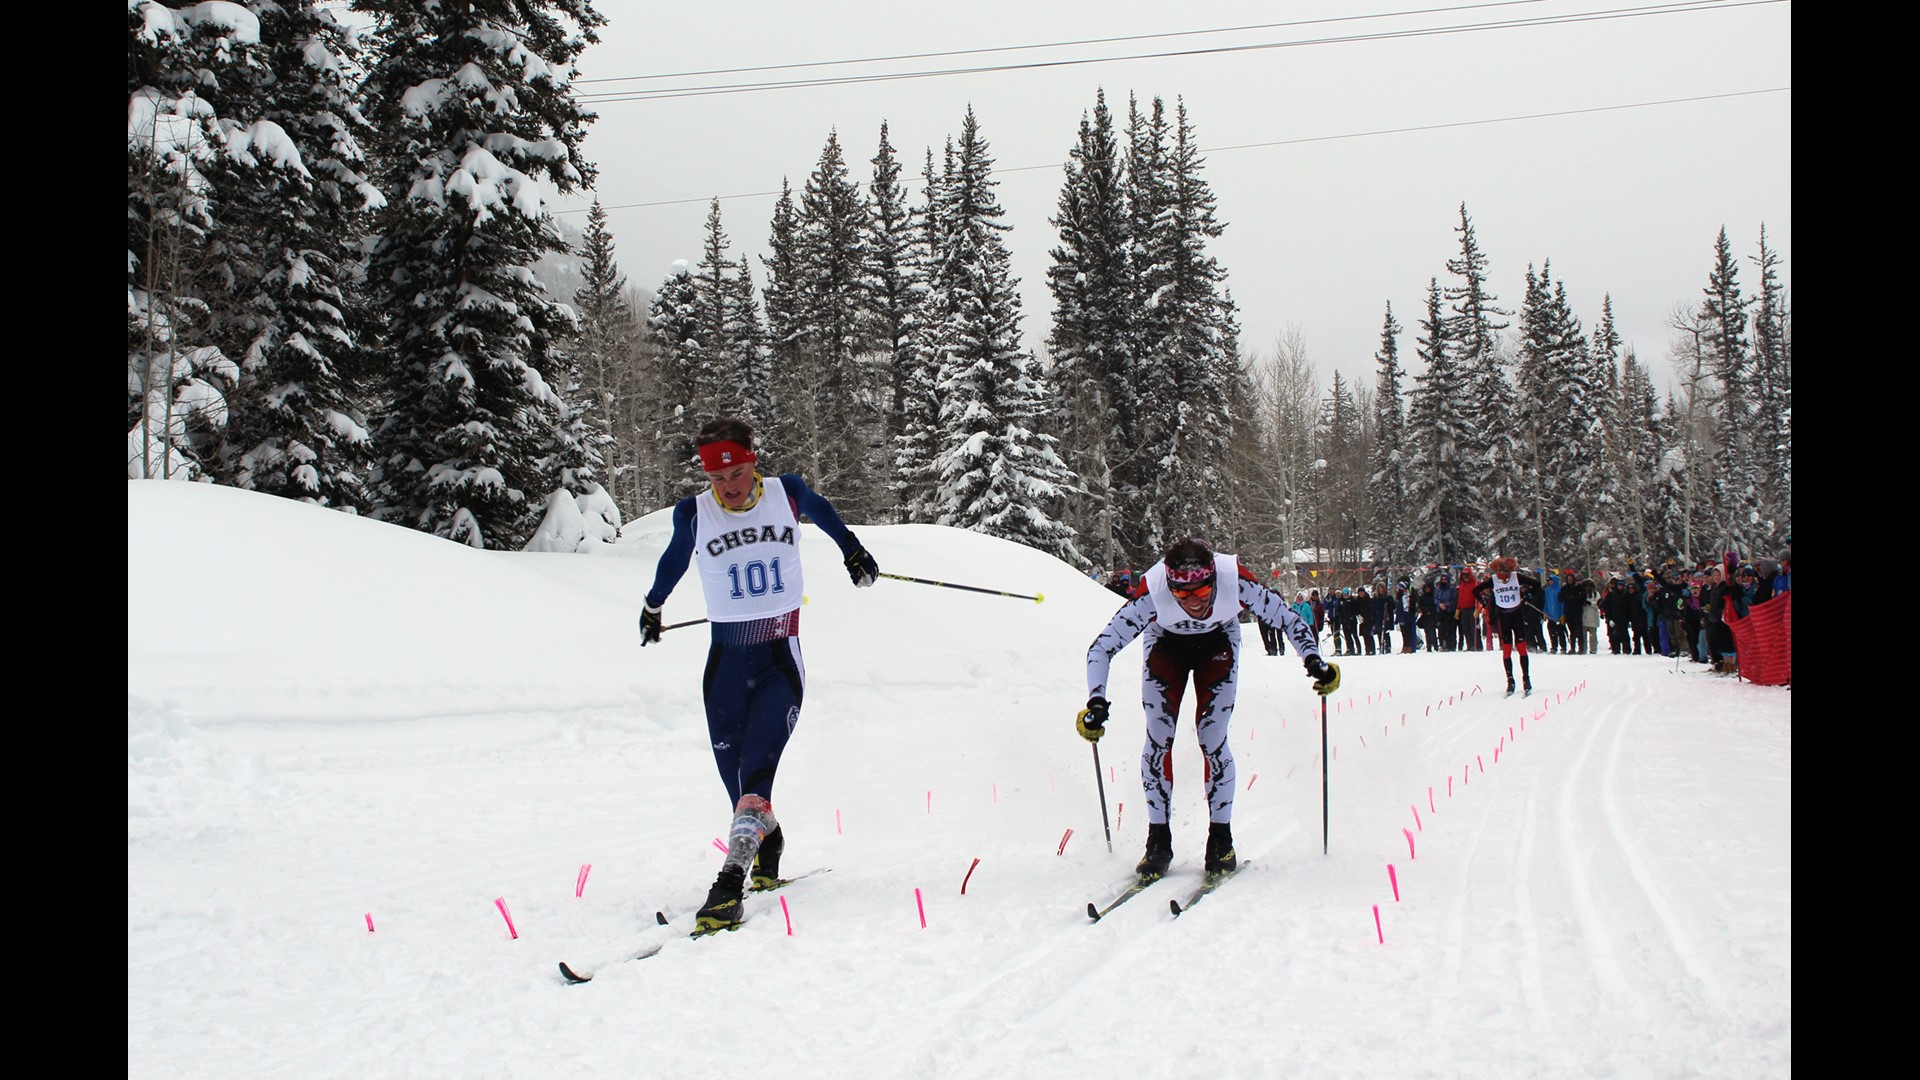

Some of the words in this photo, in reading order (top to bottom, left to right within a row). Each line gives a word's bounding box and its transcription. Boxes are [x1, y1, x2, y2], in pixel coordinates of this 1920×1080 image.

[706, 525, 795, 558] CHSAA
[728, 556, 785, 600] 101
[1499, 593, 1516, 603] 104
